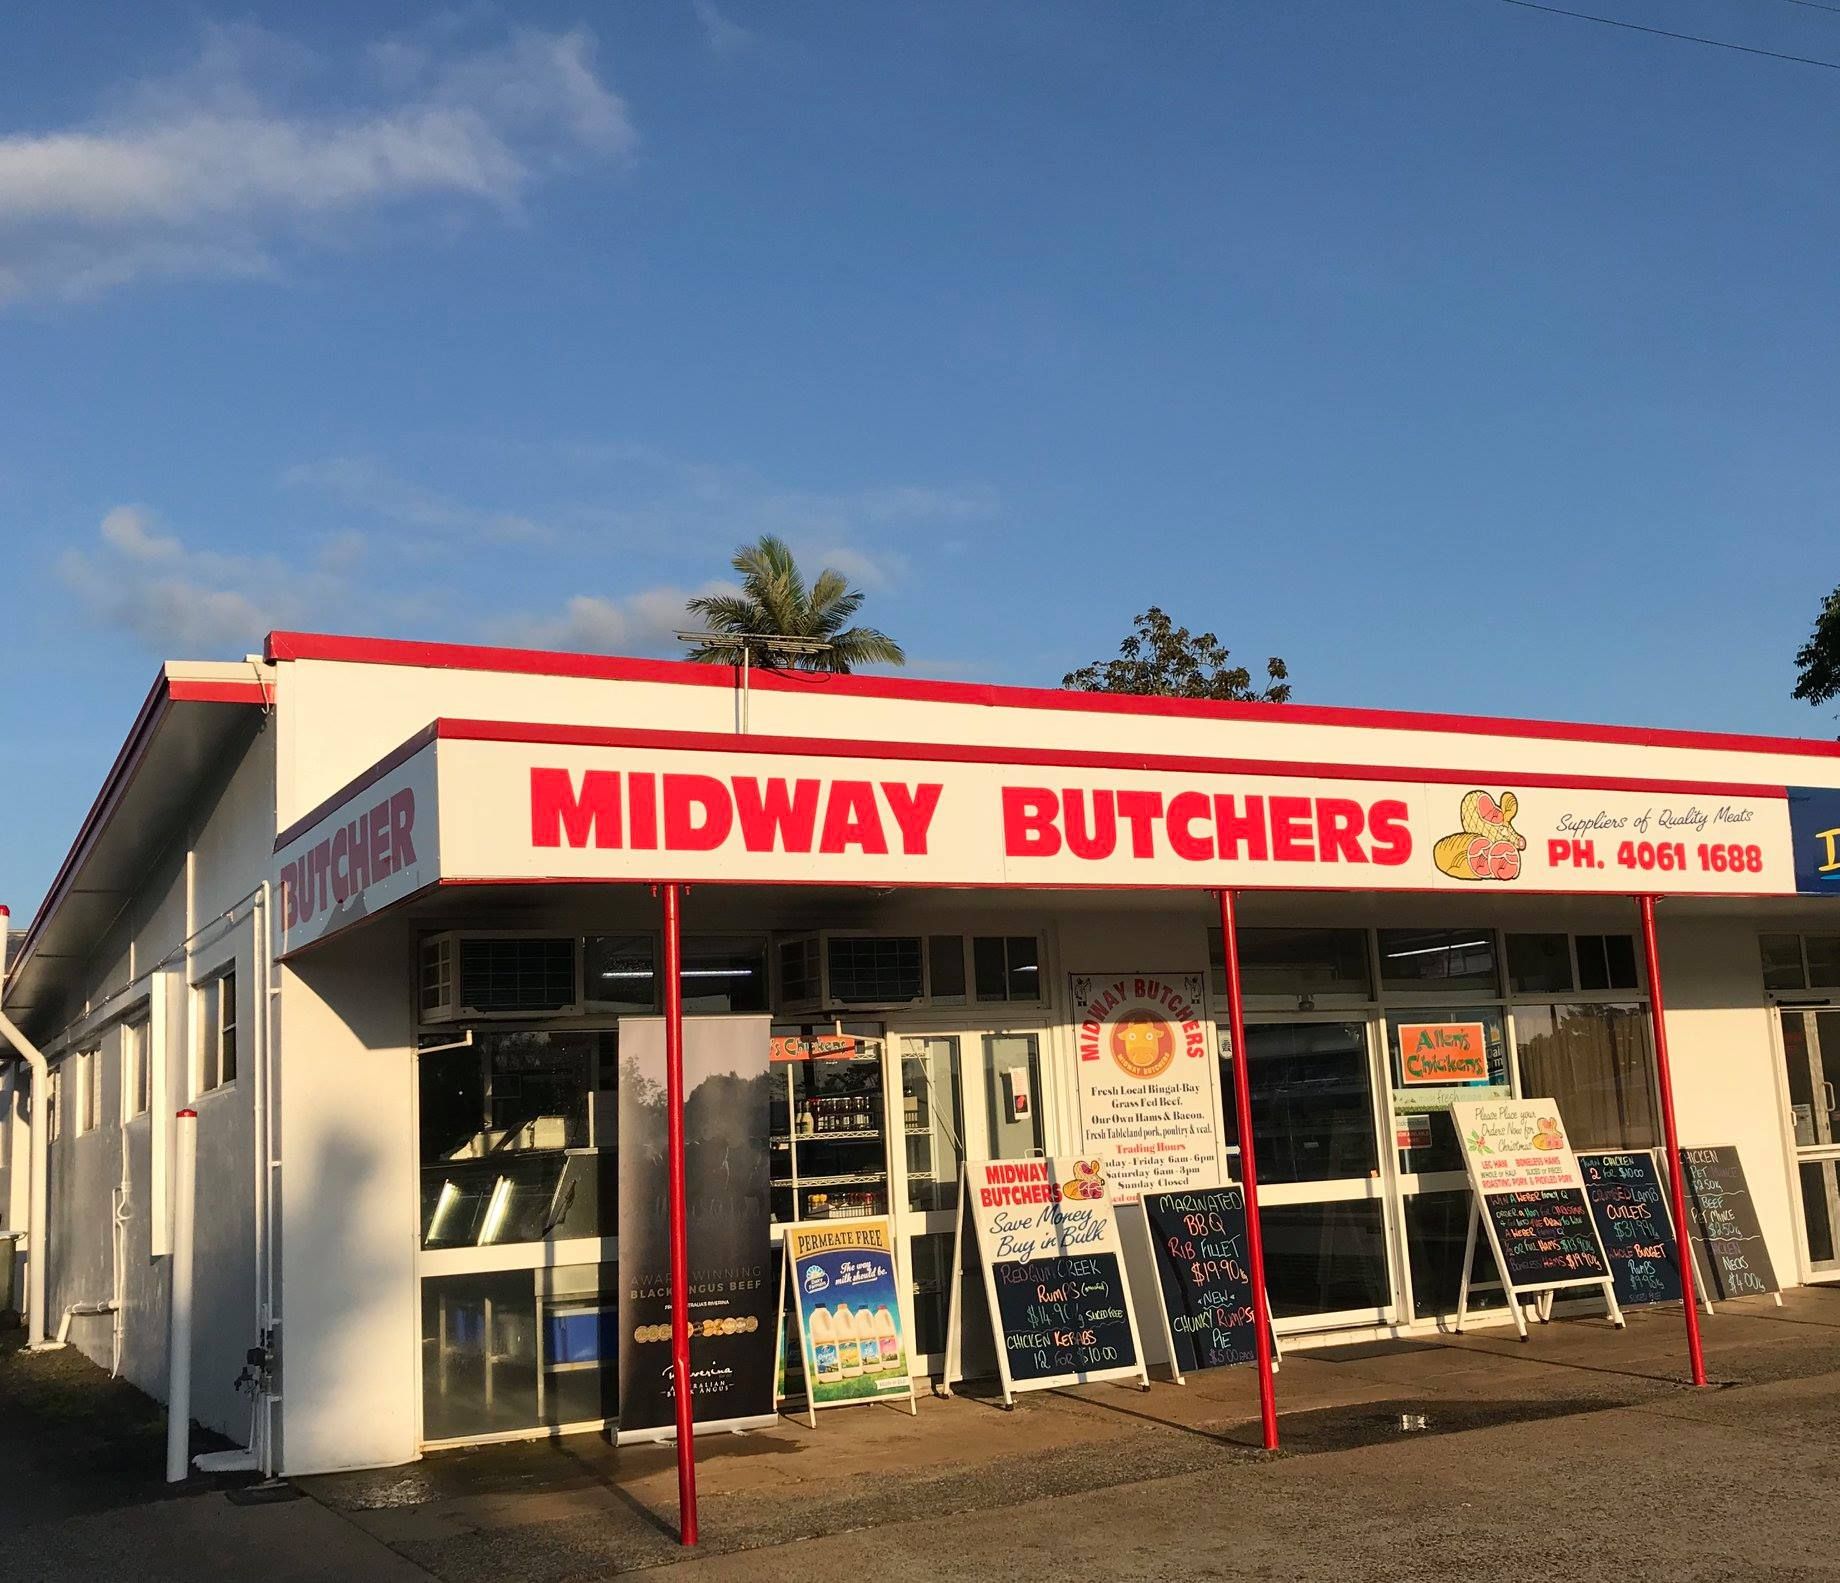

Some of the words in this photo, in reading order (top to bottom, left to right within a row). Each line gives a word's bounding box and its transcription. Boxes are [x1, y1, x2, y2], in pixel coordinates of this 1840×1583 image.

[530, 767, 943, 855] MIDWAY
[1001, 785, 1413, 865] BUTCHERS
[1556, 811, 1628, 838] Suppliers
[1633, 808, 1652, 834] of
[1658, 806, 1709, 832] Quality
[1713, 806, 1755, 823] Meats
[281, 787, 417, 932] BUTCHER
[1547, 838, 1605, 869] PH.
[1617, 841, 1687, 871] 4061
[1697, 843, 1763, 873] 1688
[1080, 980, 1127, 1062] MIDWAY
[1134, 978, 1205, 1058] BUTCHERS
[1407, 1053, 1484, 1079] Chickens
[1091, 1086, 1119, 1097] Fresh
[1120, 1085, 1147, 1096] Local
[1111, 1099, 1139, 1109] Grass
[1140, 1098, 1158, 1108] Fed
[1091, 1115, 1111, 1125] Our
[1112, 1114, 1134, 1124] Own
[1135, 1113, 1161, 1123] Hams
[1163, 1111, 1171, 1121] &
[1475, 1107, 1498, 1121] Please
[1498, 1106, 1518, 1119] Place
[1086, 1130, 1106, 1141] Fresh
[1107, 1128, 1143, 1140] Tableland
[1162, 1124, 1189, 1139] poultry
[1116, 1143, 1155, 1154] Trading
[1156, 1142, 1186, 1152] Hours
[1133, 1157, 1164, 1168] Friday
[1168, 1155, 1188, 1164] 6am
[1194, 1153, 1214, 1163] 6pm
[985, 1162, 1049, 1185] MIDWAY
[1106, 1166, 1149, 1180] Saturday
[1153, 1168, 1174, 1176] 6am
[1179, 1166, 1200, 1176] 3pm
[1589, 1167, 1601, 1180] 2
[1689, 1165, 1708, 1179] PET
[1118, 1180, 1154, 1190] Sunday
[1158, 1177, 1189, 1187] Closed
[980, 1183, 1063, 1207] BUTCHERS
[1159, 1191, 1243, 1213] MARINATED
[1560, 1190, 1568, 1200] Q
[1701, 1196, 1724, 1209] BEEF
[989, 1211, 1032, 1235] Save
[1036, 1205, 1093, 1231] Money
[1606, 1202, 1651, 1220] CUTLETS
[1183, 1212, 1226, 1237] BBQ
[798, 1230, 856, 1254] PERMEATE
[857, 1229, 883, 1248] FREE
[996, 1234, 1035, 1264] Buy
[1040, 1231, 1057, 1249] in
[1061, 1218, 1107, 1248] Bulk
[1168, 1236, 1196, 1260] RIB
[1200, 1233, 1240, 1260] FILLET
[1633, 1243, 1667, 1259] BUDGET
[631, 1272, 672, 1287] AWAR
[692, 1266, 761, 1282] WINNING
[835, 1272, 853, 1286] milk
[853, 1266, 877, 1282] should
[840, 1261, 855, 1274] The
[689, 1282, 724, 1295] NGUS
[729, 1280, 761, 1291] BEEF
[1203, 1289, 1228, 1306] NEW
[1173, 1308, 1213, 1334] CHUNKY
[1007, 1332, 1051, 1350] CHICKEN
[1212, 1327, 1232, 1349] PIE
[1033, 1350, 1051, 1370] 12
[699, 1385, 729, 1394] ANGUS
